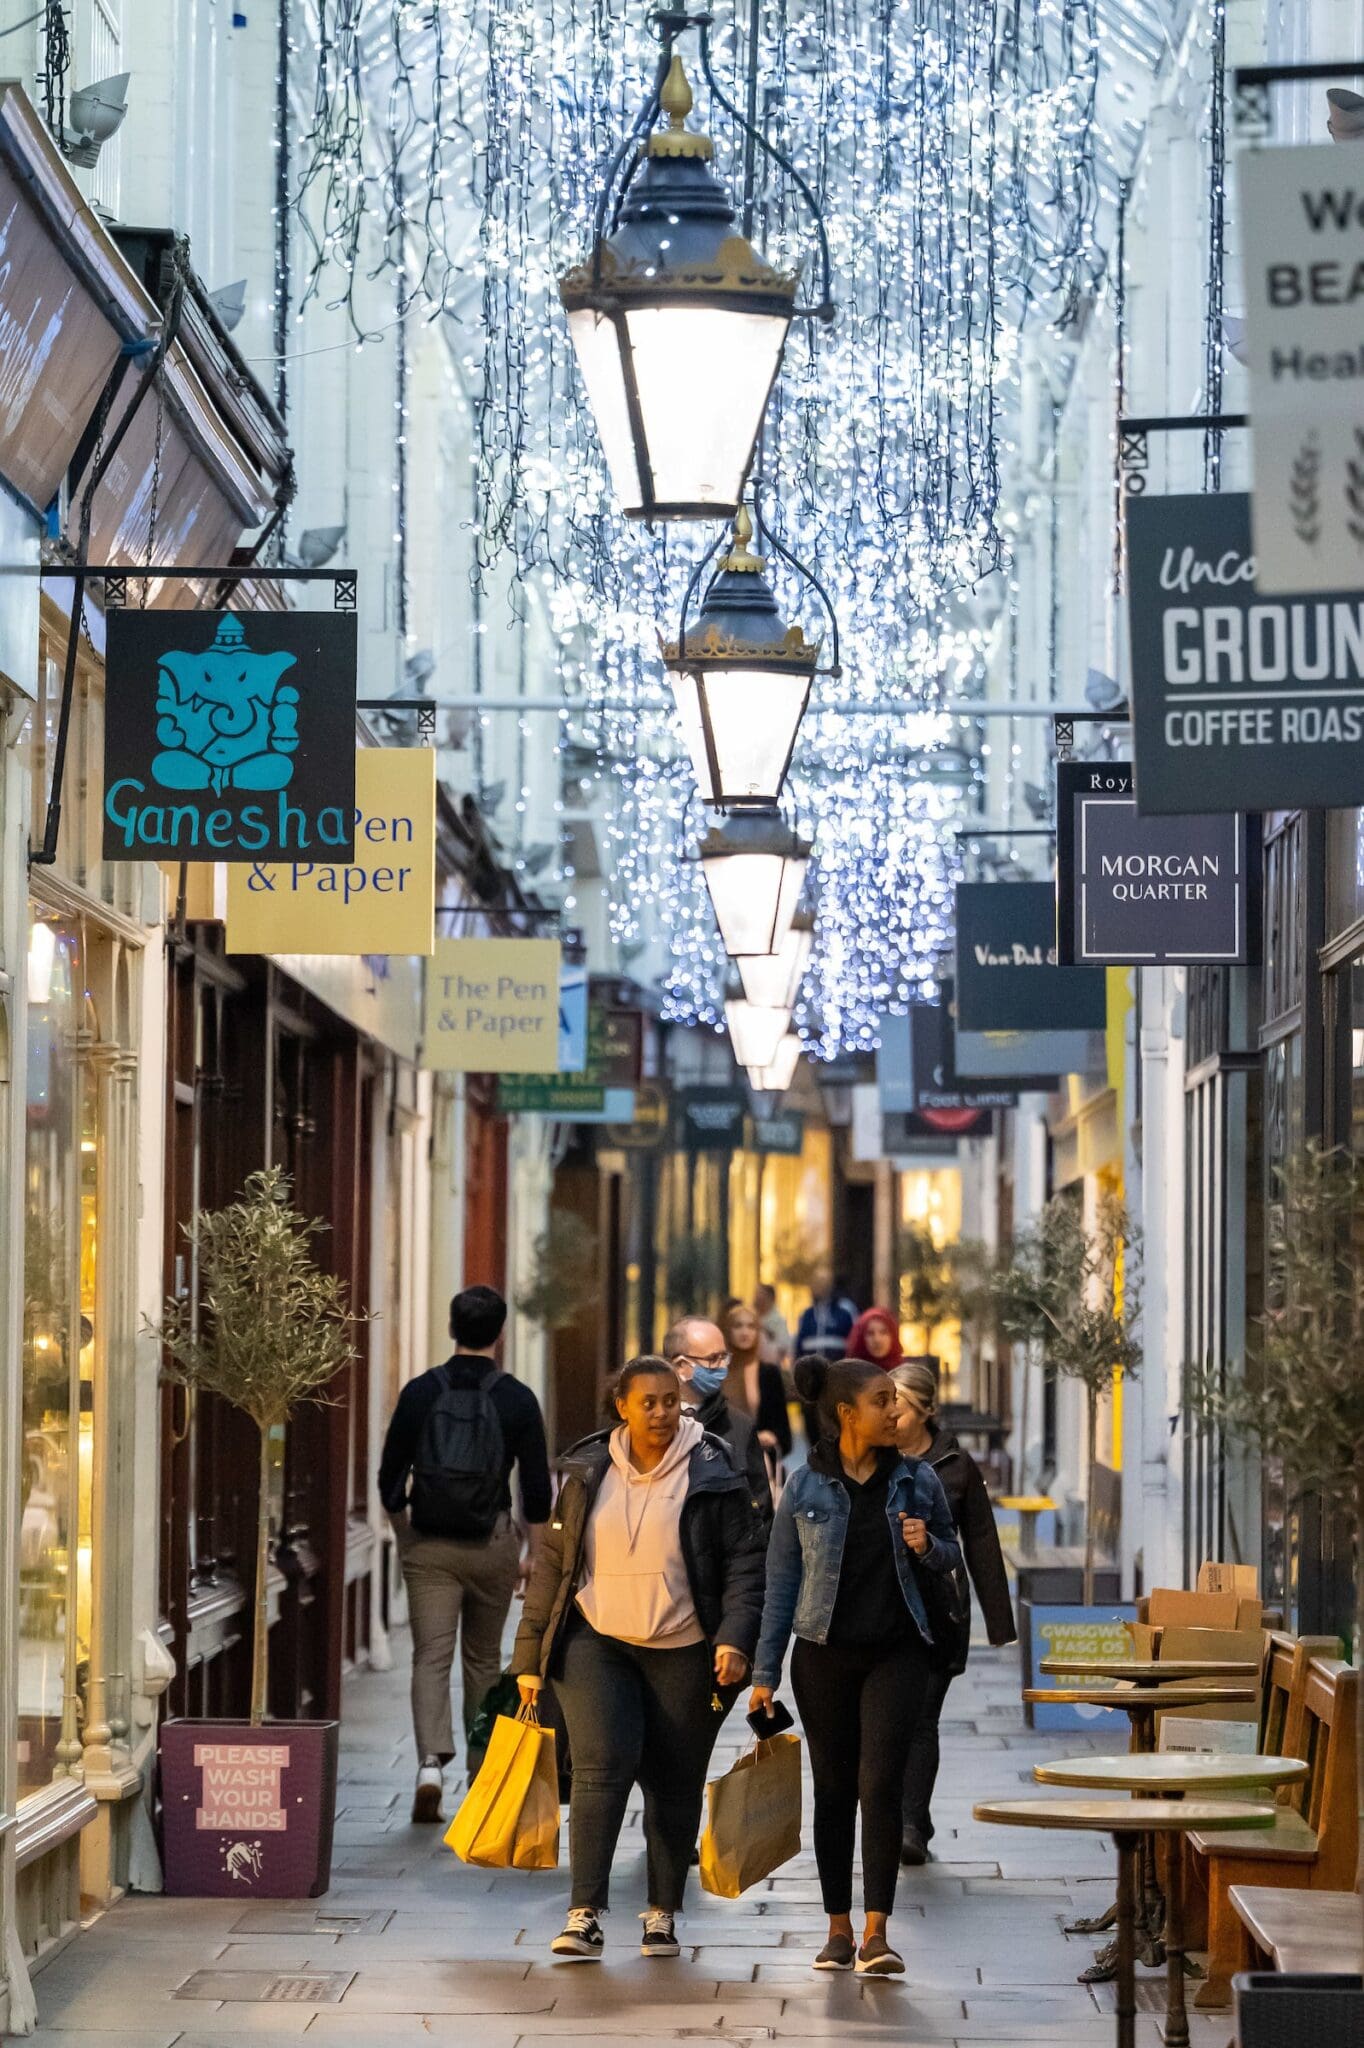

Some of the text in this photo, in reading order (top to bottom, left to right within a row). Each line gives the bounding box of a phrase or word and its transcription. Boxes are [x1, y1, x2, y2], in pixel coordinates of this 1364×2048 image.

[1162, 604, 1364, 685] GROUN
[1165, 706, 1364, 747] COFFEE ROAS
[105, 778, 352, 851] Ganesha
[1101, 855, 1219, 877] MORGAN
[247, 862, 412, 905] & Paper
[1112, 883, 1208, 902] QUARTER
[439, 975, 547, 1000] The Pen
[437, 1008, 456, 1033] &
[466, 1007, 545, 1038] Paper
[1101, 1640, 1125, 1654] OS
[200, 1747, 284, 1765] PLEASE
[207, 1768, 276, 1787] WASH
[210, 1789, 273, 1806] YOUR
[201, 1810, 282, 1829] HANDS
